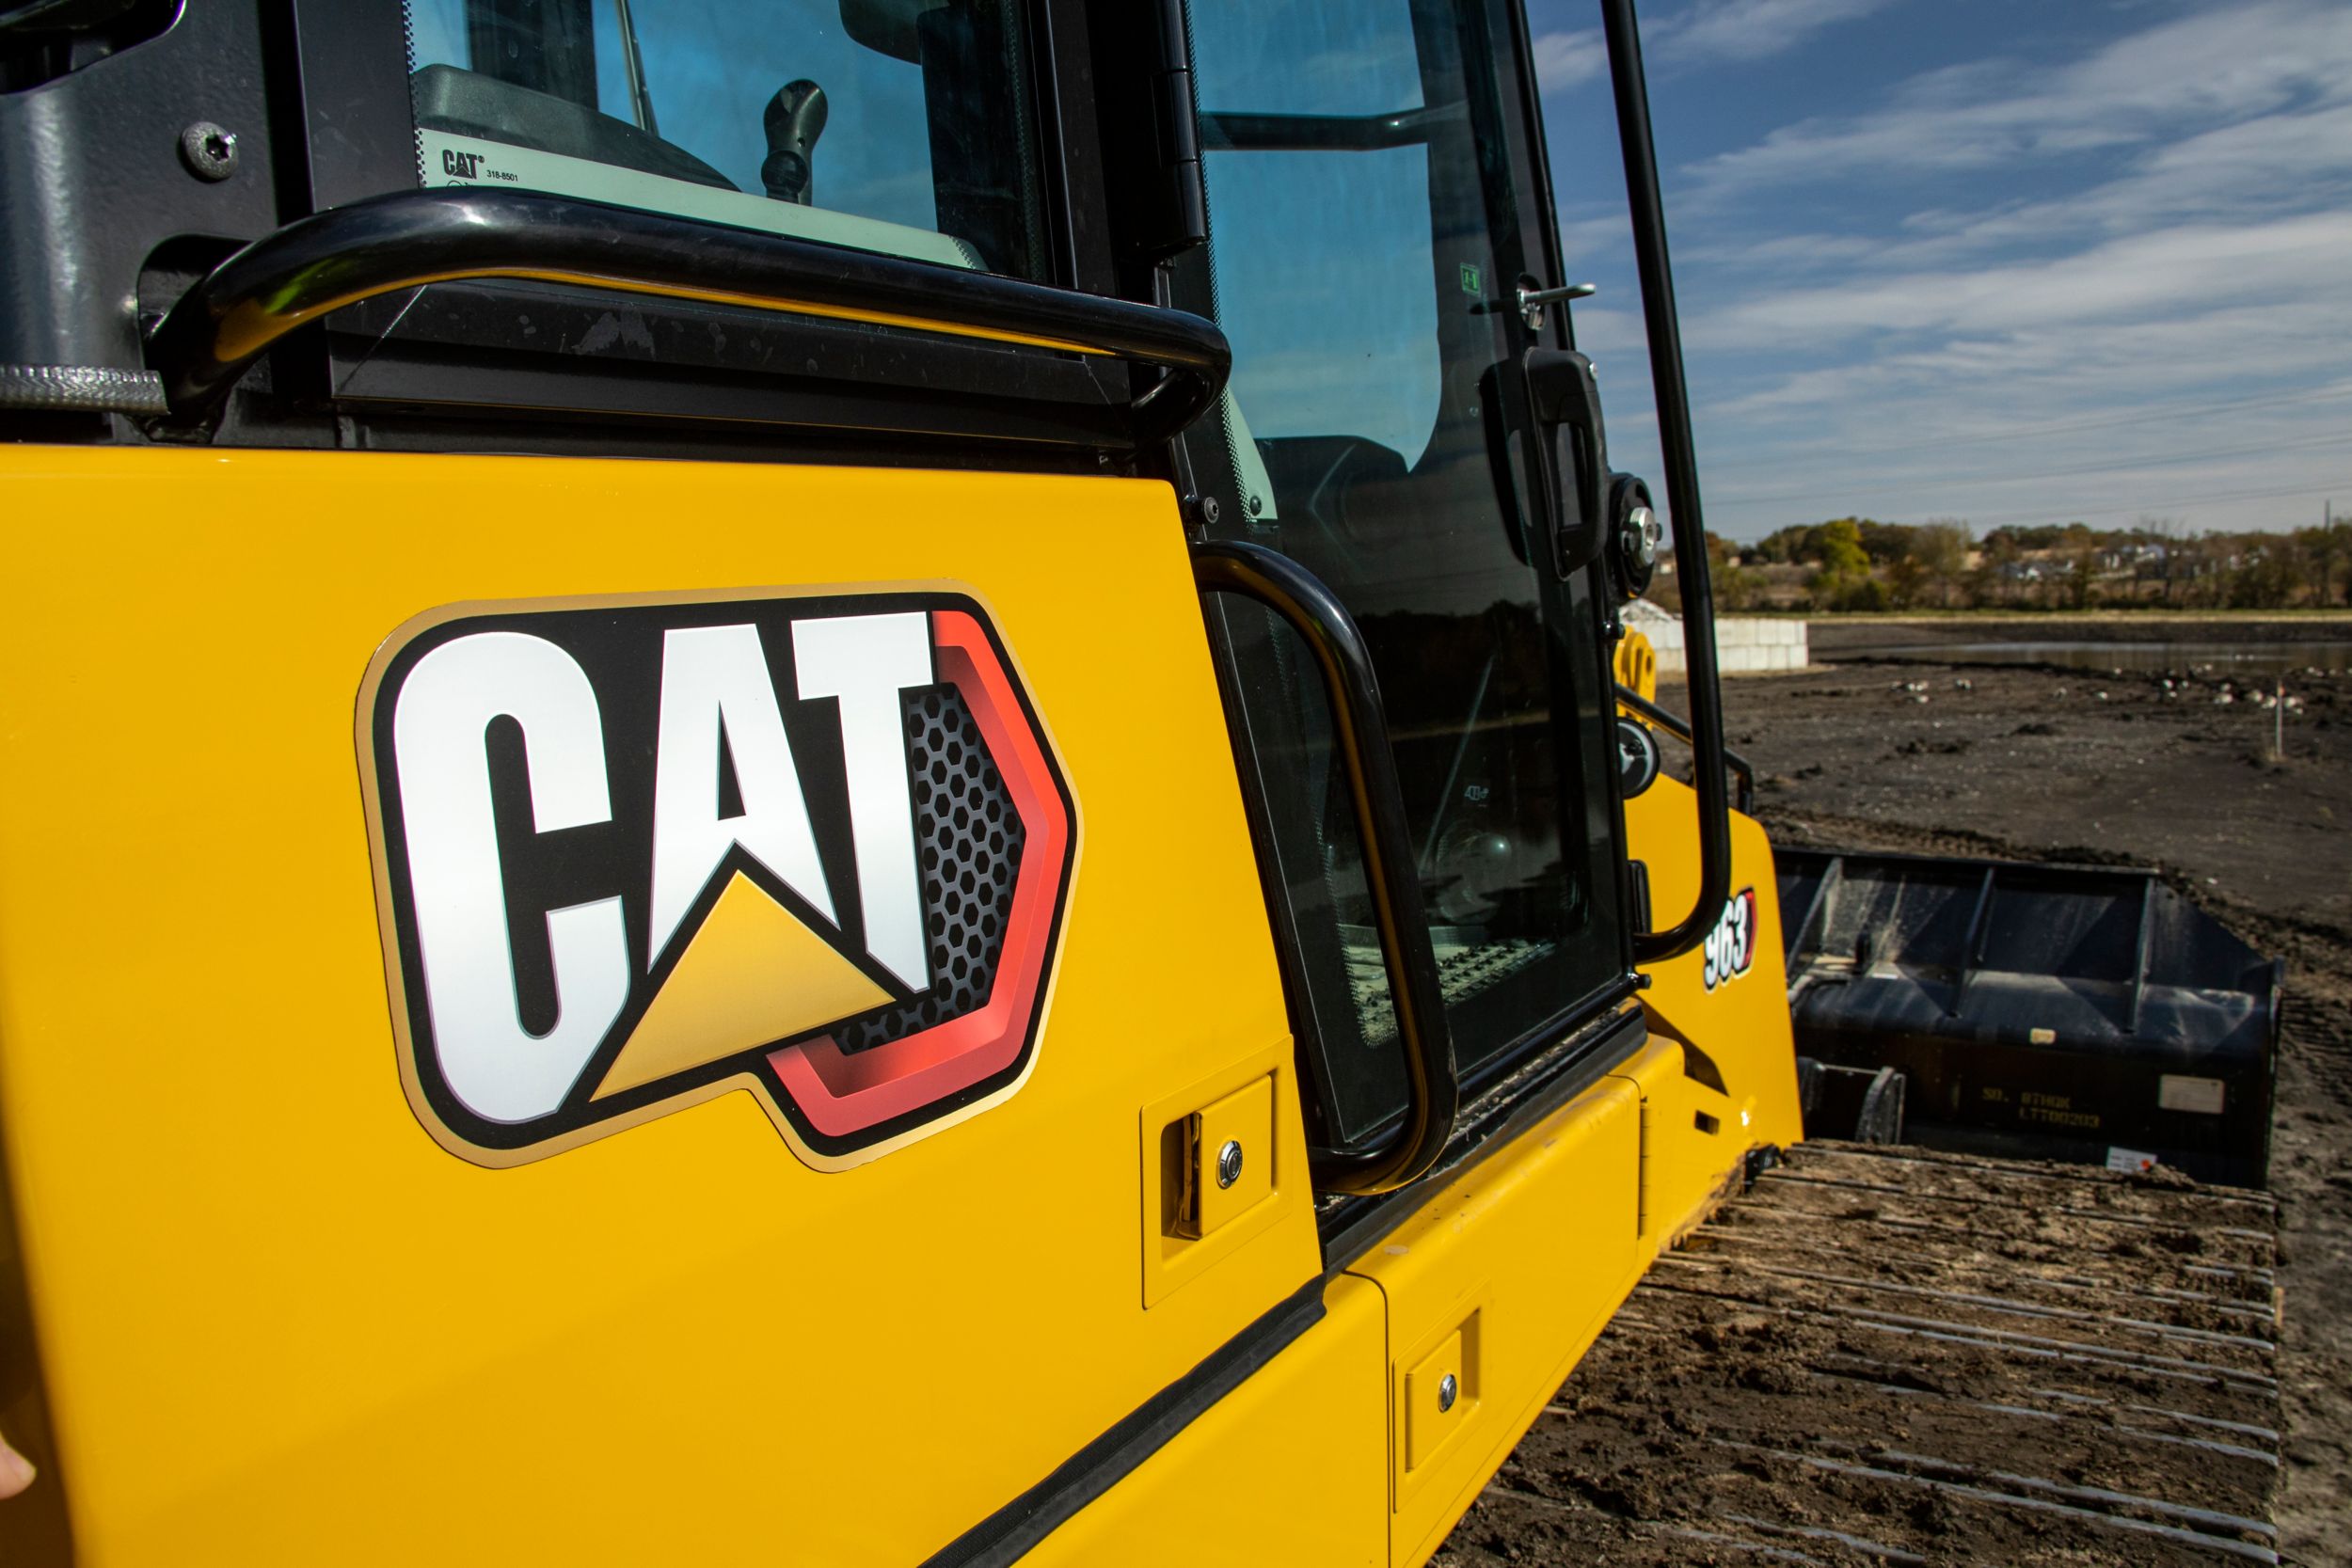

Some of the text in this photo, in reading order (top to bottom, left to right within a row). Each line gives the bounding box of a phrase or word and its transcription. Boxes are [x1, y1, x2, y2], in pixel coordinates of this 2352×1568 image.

[486, 169, 518, 182] 318-8501
[394, 611, 933, 1125] CAT
[1704, 894, 1748, 986] 963
